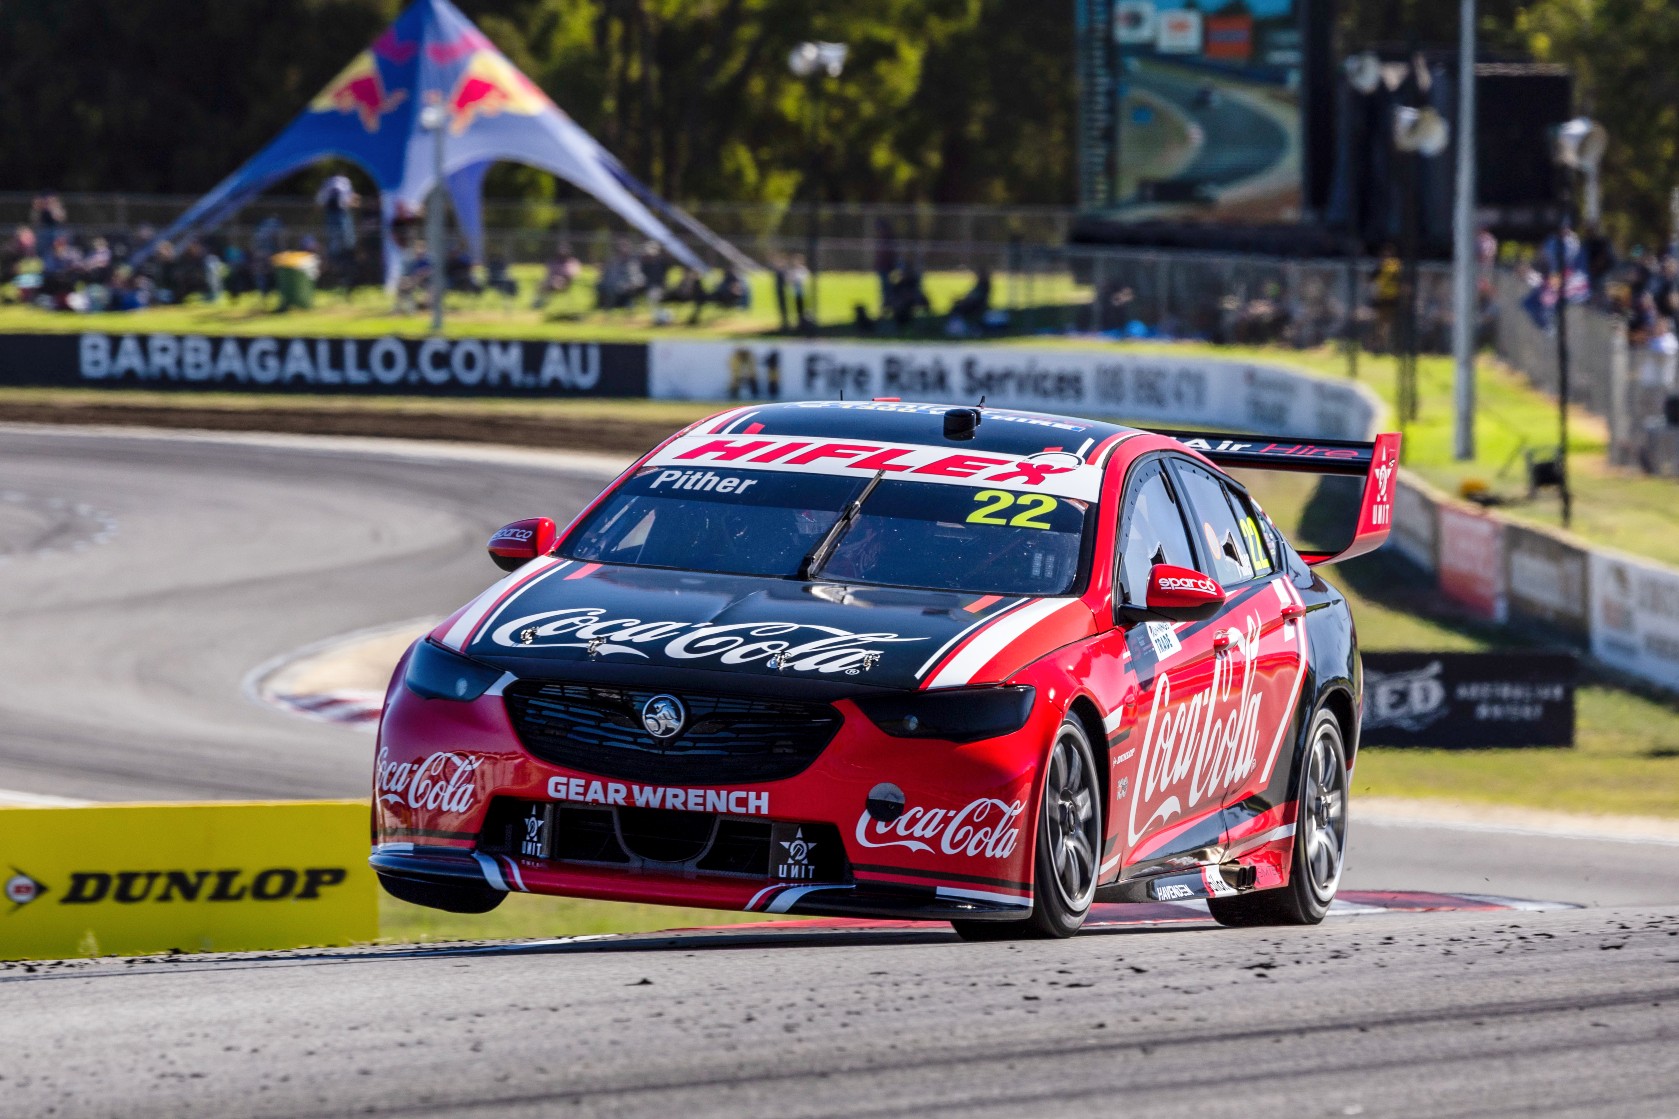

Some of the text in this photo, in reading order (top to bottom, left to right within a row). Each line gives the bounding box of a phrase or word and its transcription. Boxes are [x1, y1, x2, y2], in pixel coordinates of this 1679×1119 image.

[80, 334, 601, 390] BARBAGALLO.COM.AU
[804, 353, 871, 391] Fire
[882, 354, 950, 394] Risk
[962, 356, 1084, 401] Services
[674, 439, 1075, 486] HIFLEX
[1183, 437, 1359, 458] Air Hire
[649, 469, 757, 496] Pither
[965, 489, 1058, 530] 22
[1372, 503, 1390, 525] UNIT
[1239, 516, 1271, 572] 22
[1158, 577, 1217, 596] sparco
[547, 775, 769, 815] GEAR WRENCH
[855, 797, 1028, 859] Coca-Cola
[521, 841, 542, 857] UNIT
[60, 868, 347, 904] DUNLOP
[778, 864, 815, 879] UNIT
